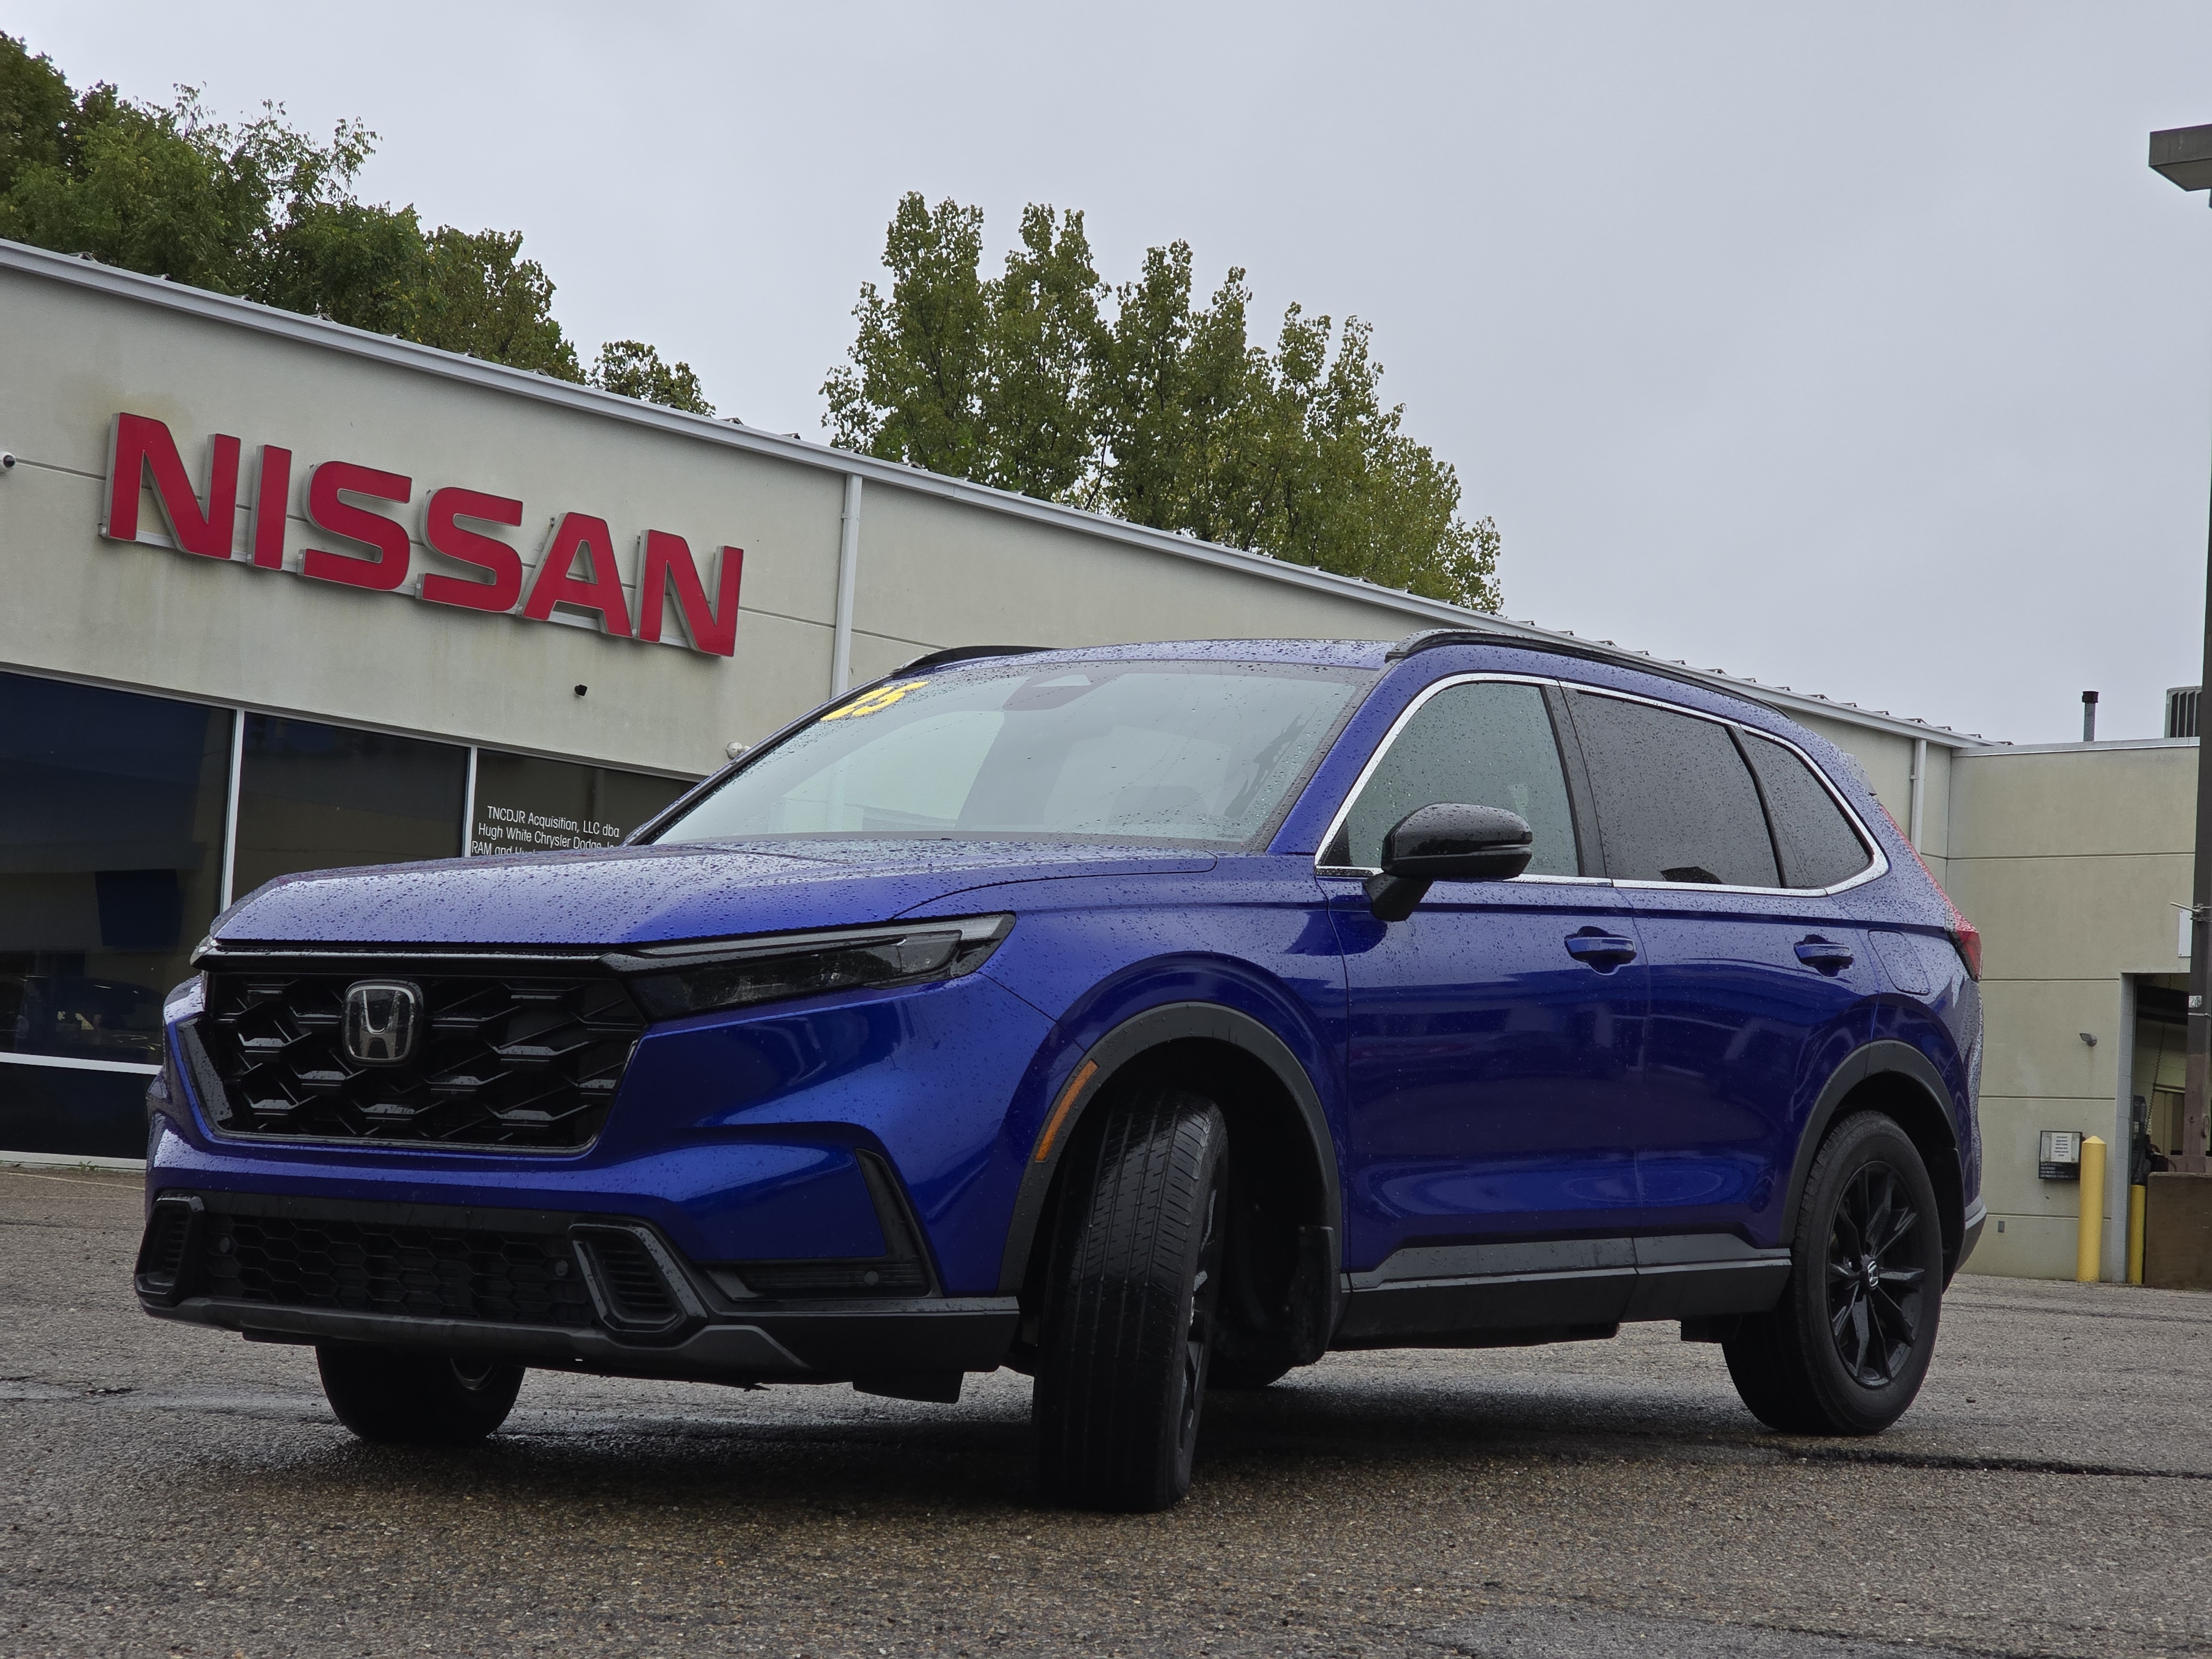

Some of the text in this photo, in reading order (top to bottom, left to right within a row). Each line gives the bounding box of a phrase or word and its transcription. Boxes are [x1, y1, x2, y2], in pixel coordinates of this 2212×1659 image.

[102, 412, 744, 658] NISSAN
[478, 822, 503, 841] Hugh
[506, 826, 532, 842] White
[534, 831, 571, 848] Chrysler
[487, 805, 619, 838] TNCDJR Acquisition, LLC dba
[472, 841, 492, 855] RAM
[494, 846, 512, 855] and
